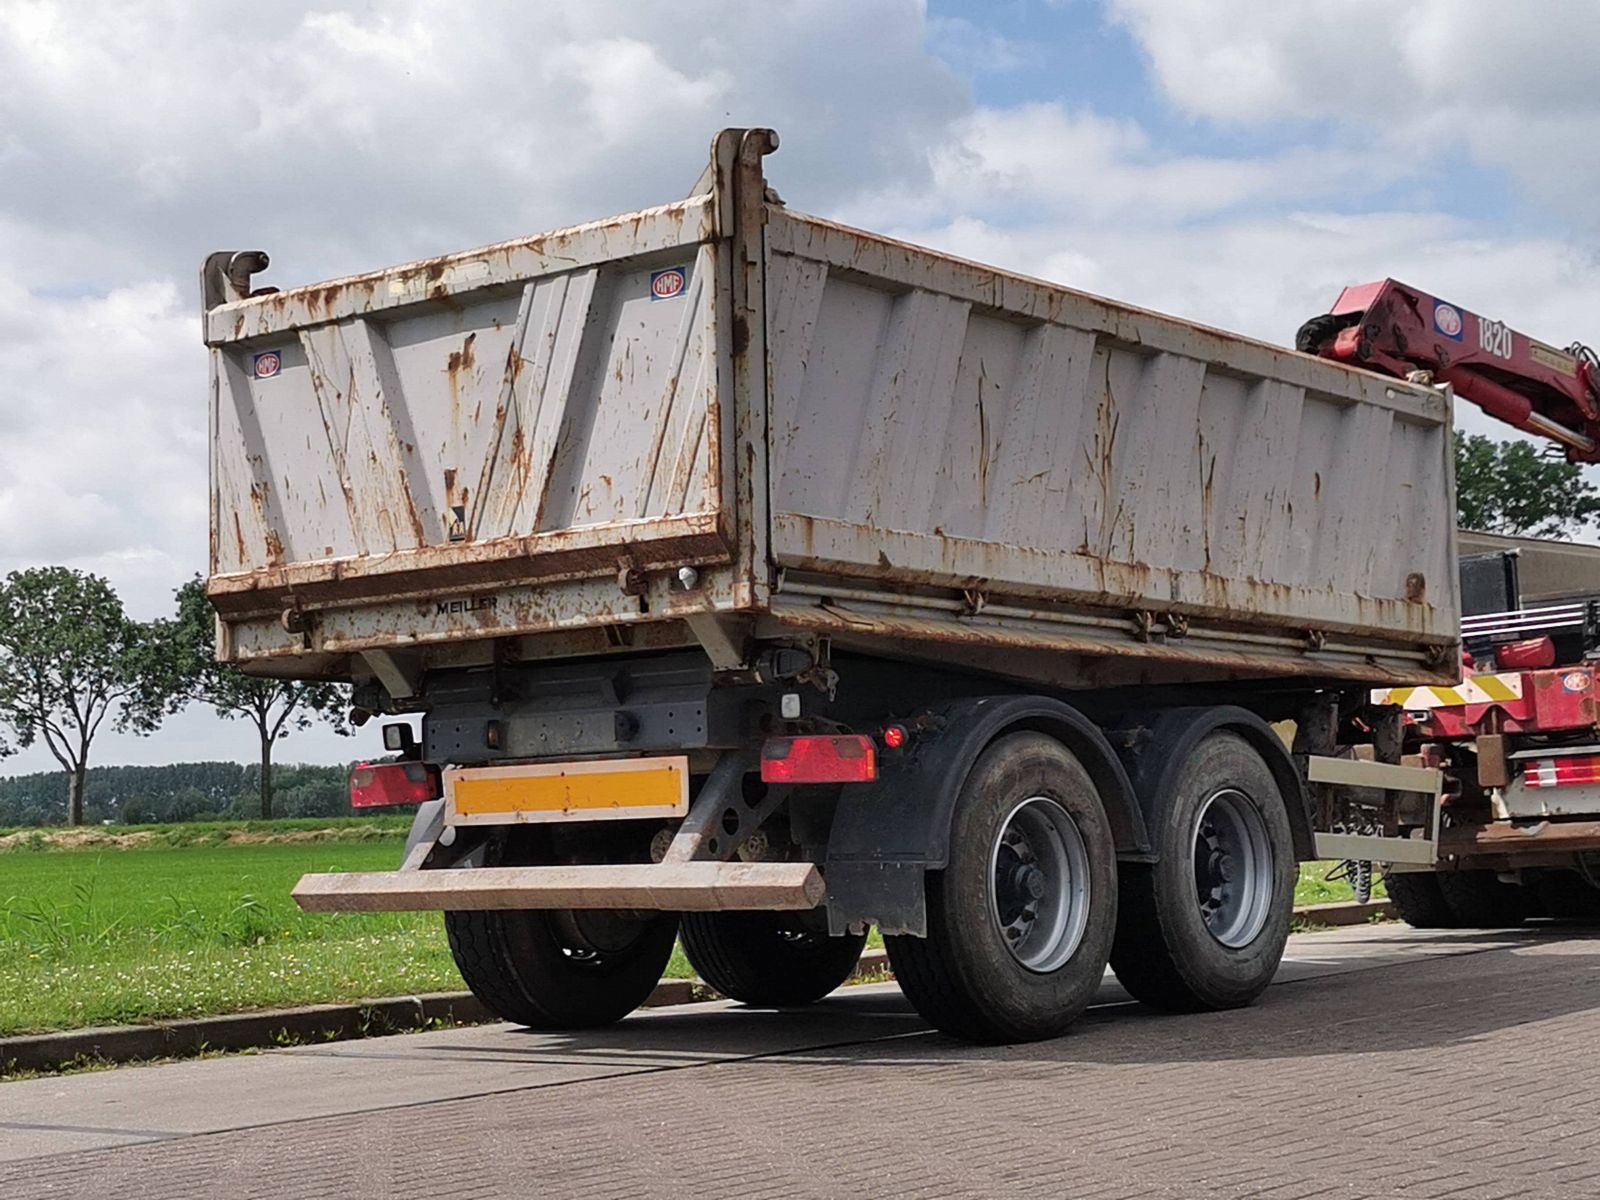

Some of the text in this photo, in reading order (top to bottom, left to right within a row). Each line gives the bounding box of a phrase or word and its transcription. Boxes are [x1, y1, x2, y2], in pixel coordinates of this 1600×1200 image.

[656, 274, 680, 294] HMF
[1478, 318, 1512, 360] 1820
[436, 597, 498, 615] MEILLER
